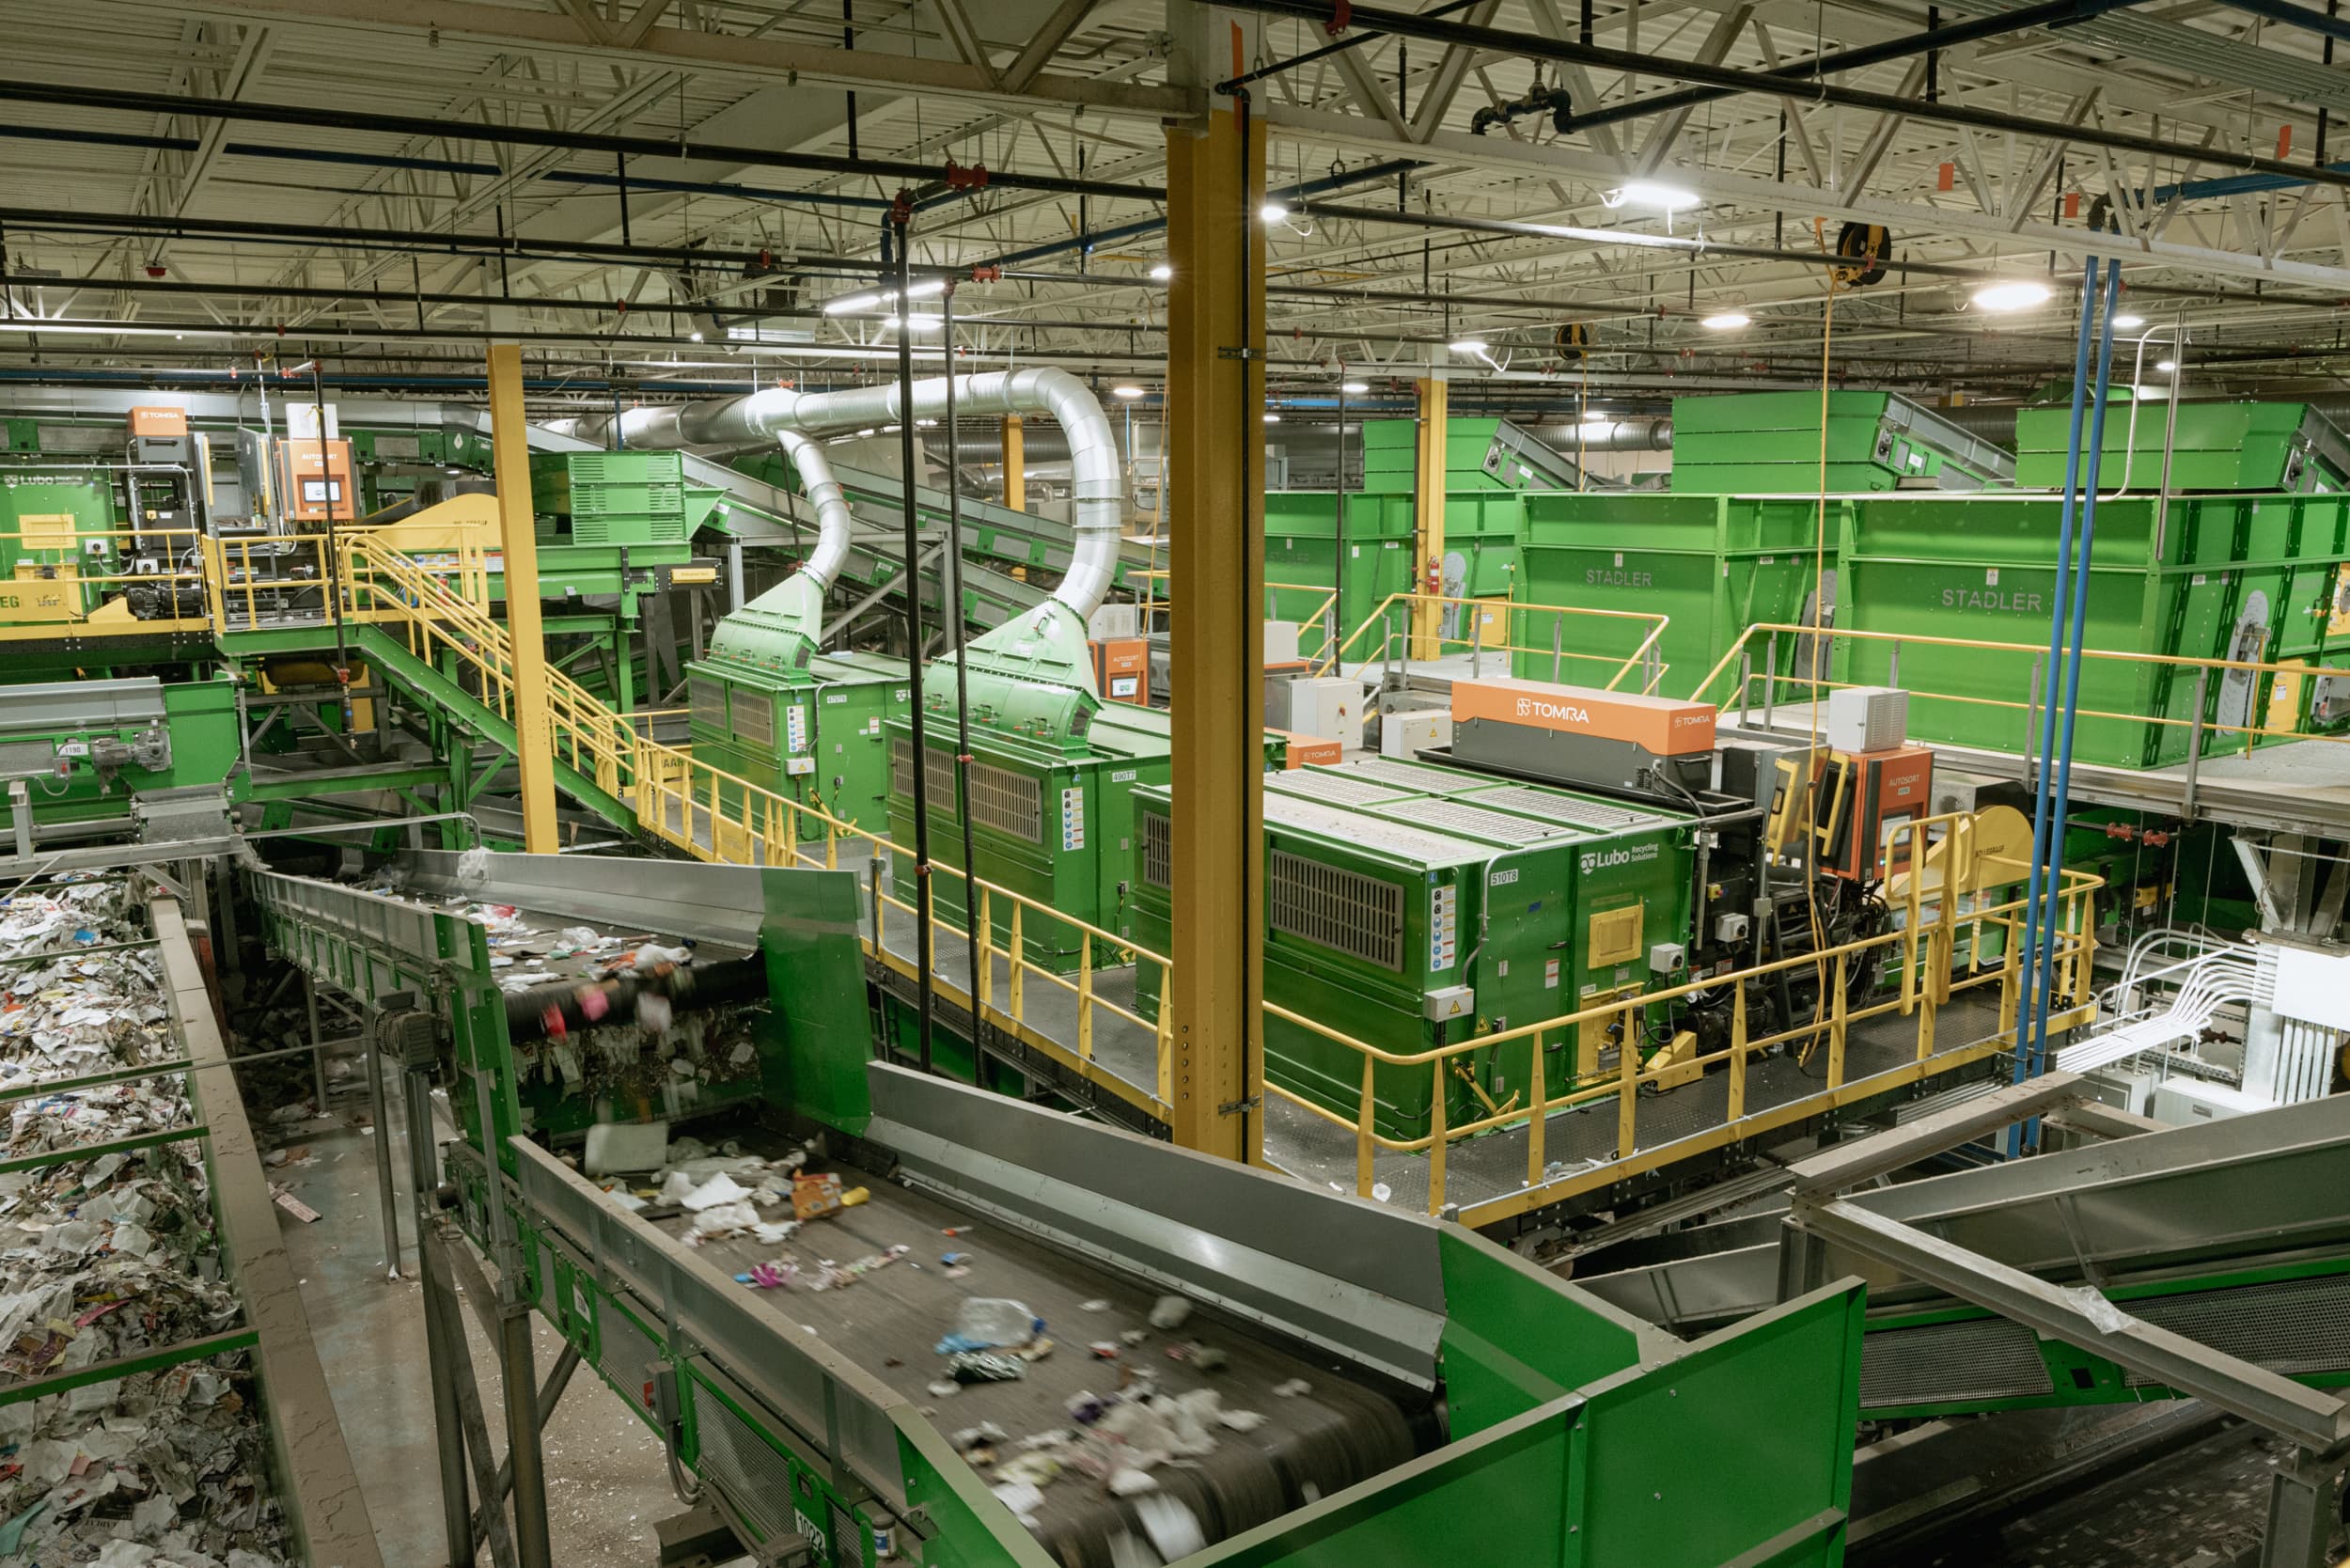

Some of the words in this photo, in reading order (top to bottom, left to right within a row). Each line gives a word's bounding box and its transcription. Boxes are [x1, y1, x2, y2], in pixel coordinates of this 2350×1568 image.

[20, 475, 54, 485] Lubo
[1586, 570, 1653, 587] STADLER
[1942, 588, 2042, 612] STADLER
[1532, 701, 1590, 723] TOMRA
[1684, 715, 1711, 726] TOMRA
[1888, 774, 1920, 787] AUTOSORT
[1632, 843, 1659, 854] Recycling
[1597, 849, 1630, 868] Lubo
[1632, 852, 1658, 862] Solutions
[1492, 870, 1518, 885] 510T8
[797, 1514, 824, 1554] 1022
